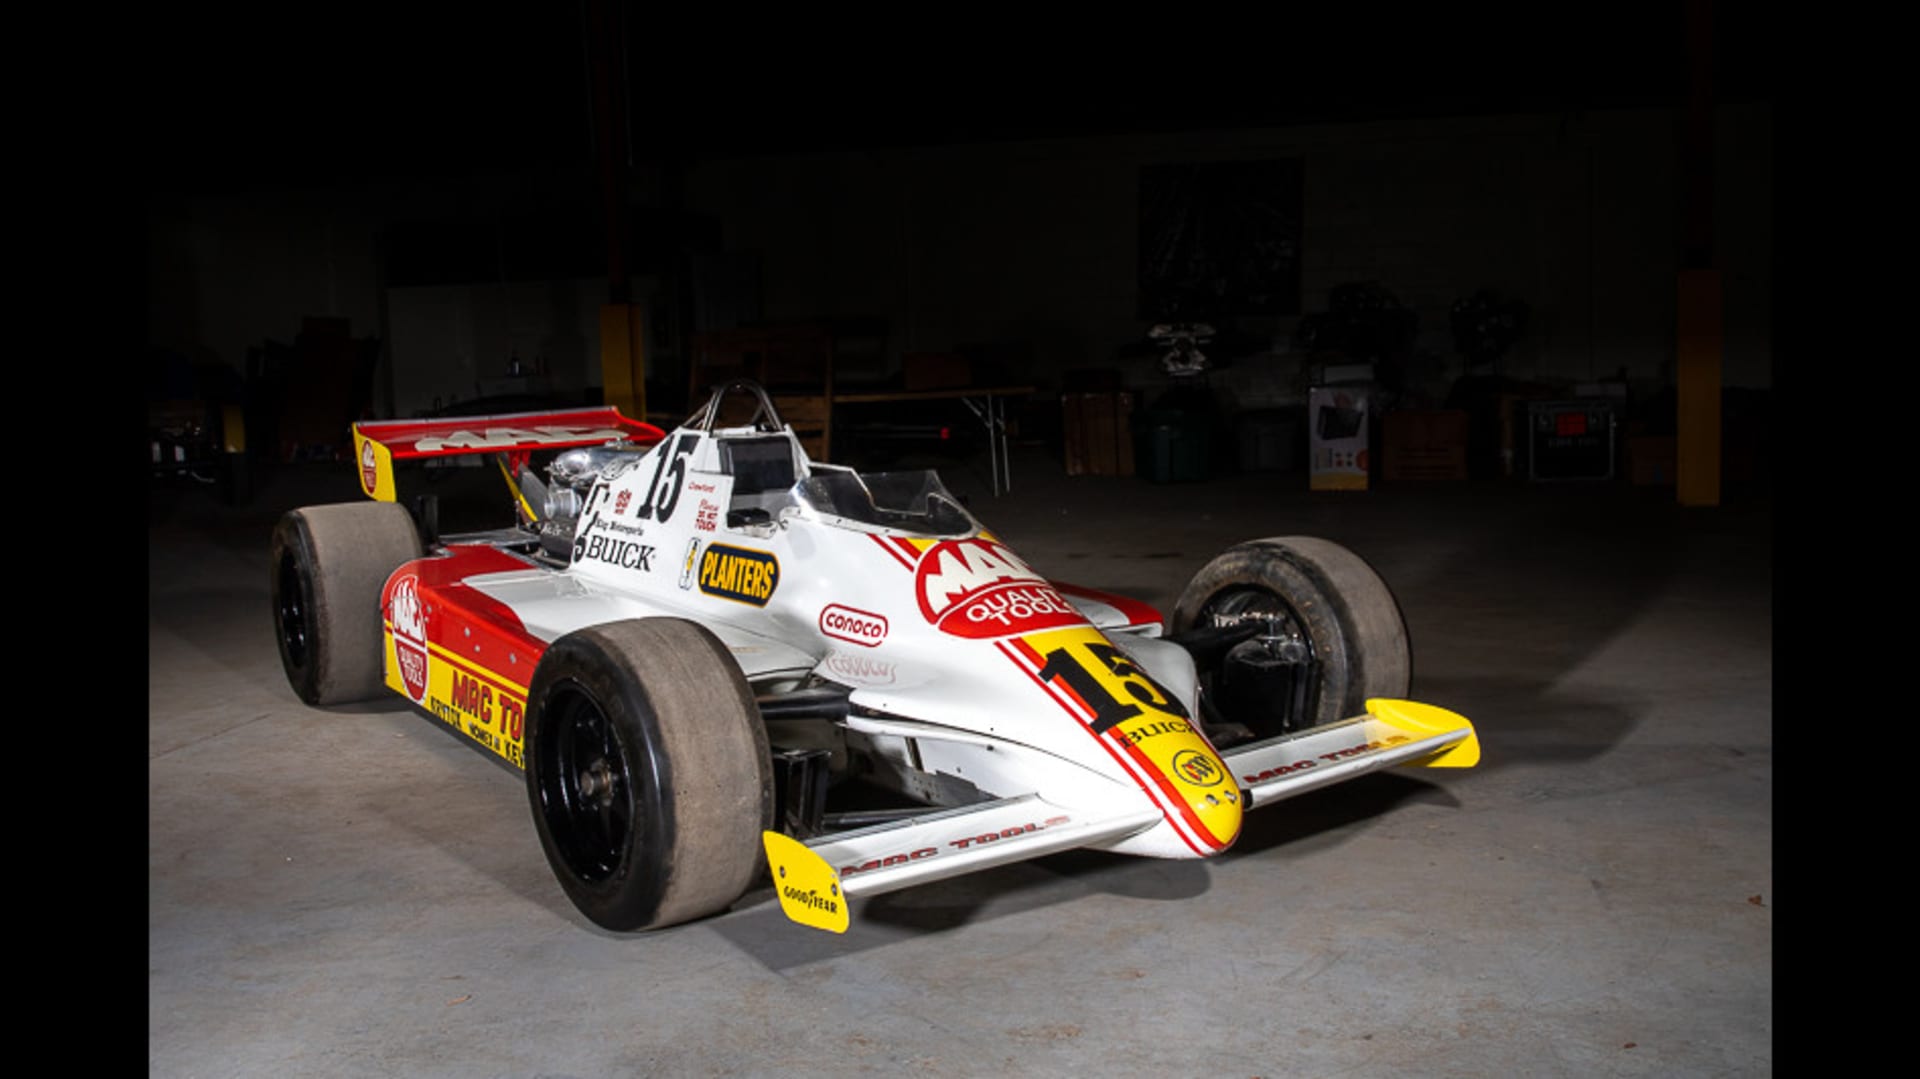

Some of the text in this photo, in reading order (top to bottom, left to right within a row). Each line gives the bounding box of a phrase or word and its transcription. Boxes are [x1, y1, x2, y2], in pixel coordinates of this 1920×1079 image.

[415, 426, 629, 451] MAC
[637, 433, 701, 524] 15
[585, 535, 652, 572] BUICK
[700, 551, 775, 599] PLANTERS
[394, 580, 425, 643] MAC
[966, 586, 1062, 622] QUALIT
[452, 670, 525, 743] MAC TO
[1038, 643, 1190, 736] 15
[840, 815, 1071, 878] MAC TOOLS
[783, 885, 838, 914] GOODYEAR
